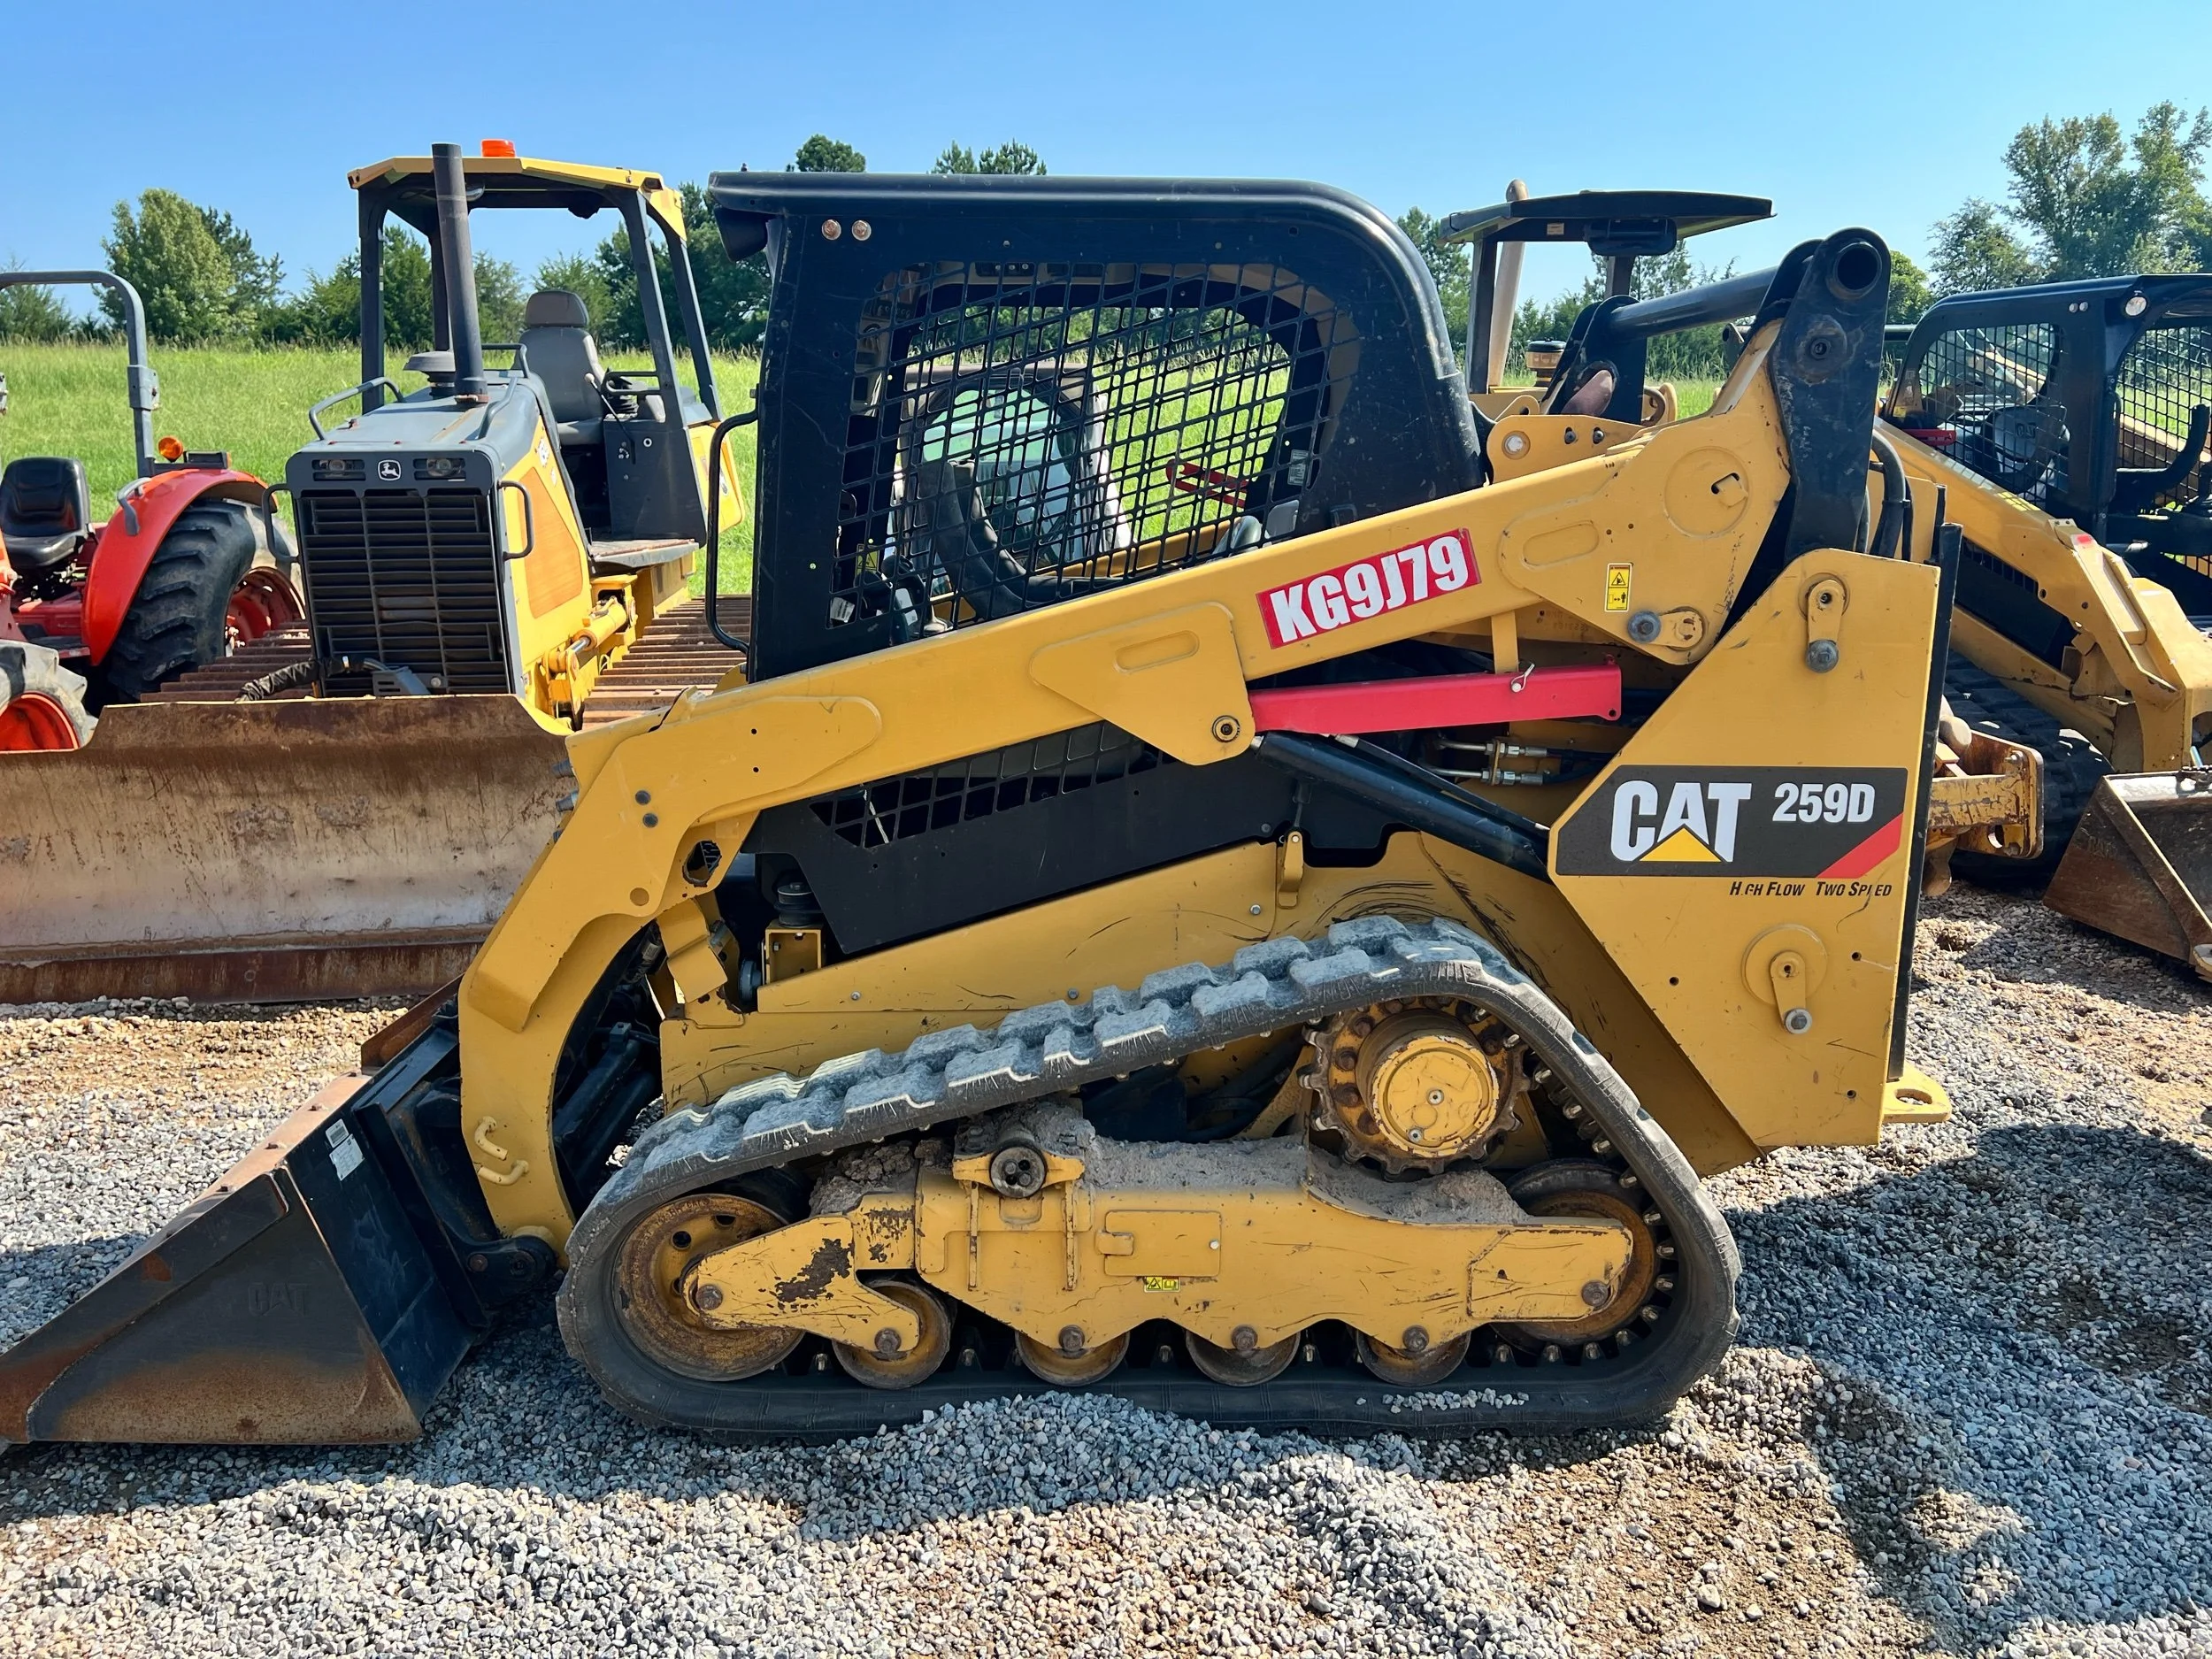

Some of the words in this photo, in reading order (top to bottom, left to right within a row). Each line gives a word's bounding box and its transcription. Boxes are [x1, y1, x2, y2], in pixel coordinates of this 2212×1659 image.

[1269, 535, 1469, 643] KG9J79
[1610, 780, 1753, 863] CAT
[1772, 782, 1876, 823] 259D
[1729, 881, 1764, 896] HGH
[1766, 881, 1806, 896] FLOW
[1816, 881, 1846, 896] TWO
[248, 1282, 312, 1317] CAT
